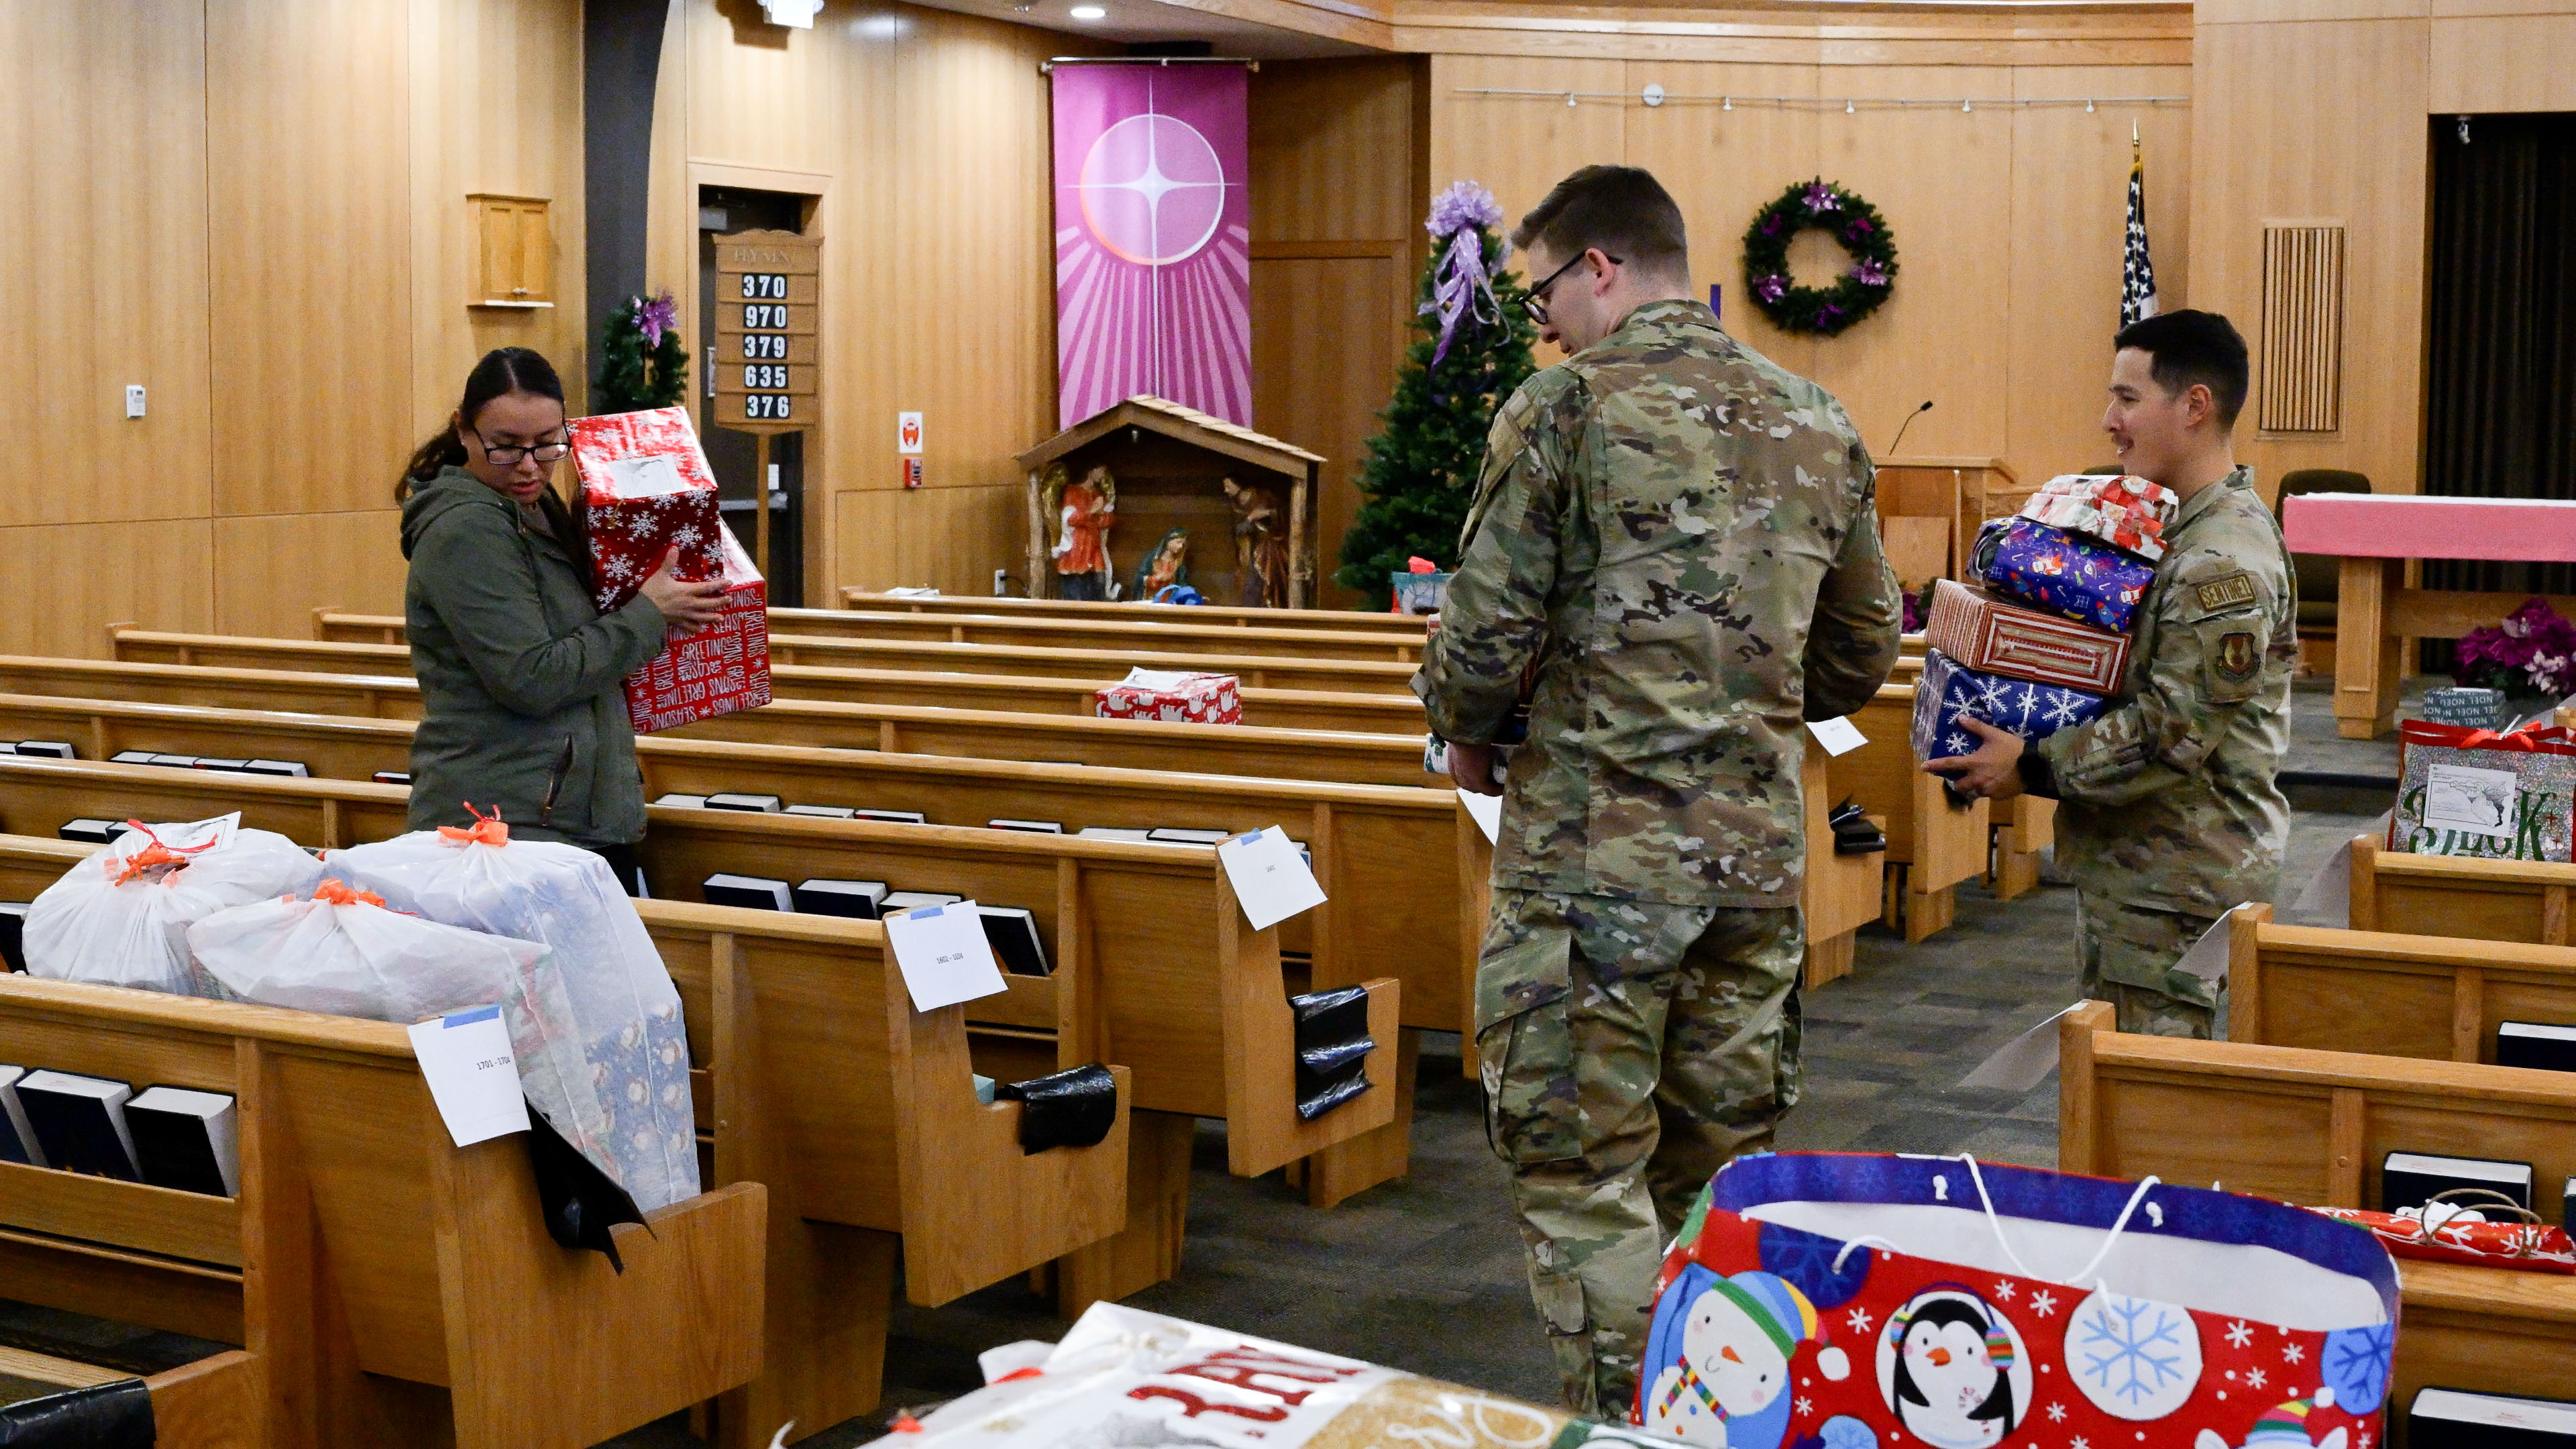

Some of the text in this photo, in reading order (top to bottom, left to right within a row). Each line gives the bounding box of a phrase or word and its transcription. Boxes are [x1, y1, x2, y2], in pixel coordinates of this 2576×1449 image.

[743, 276, 786, 298] 370
[745, 306, 786, 328] 970
[744, 336, 786, 358] 379
[744, 366, 786, 388] 635
[747, 396, 790, 418] 376
[477, 1059, 494, 1070] 1701
